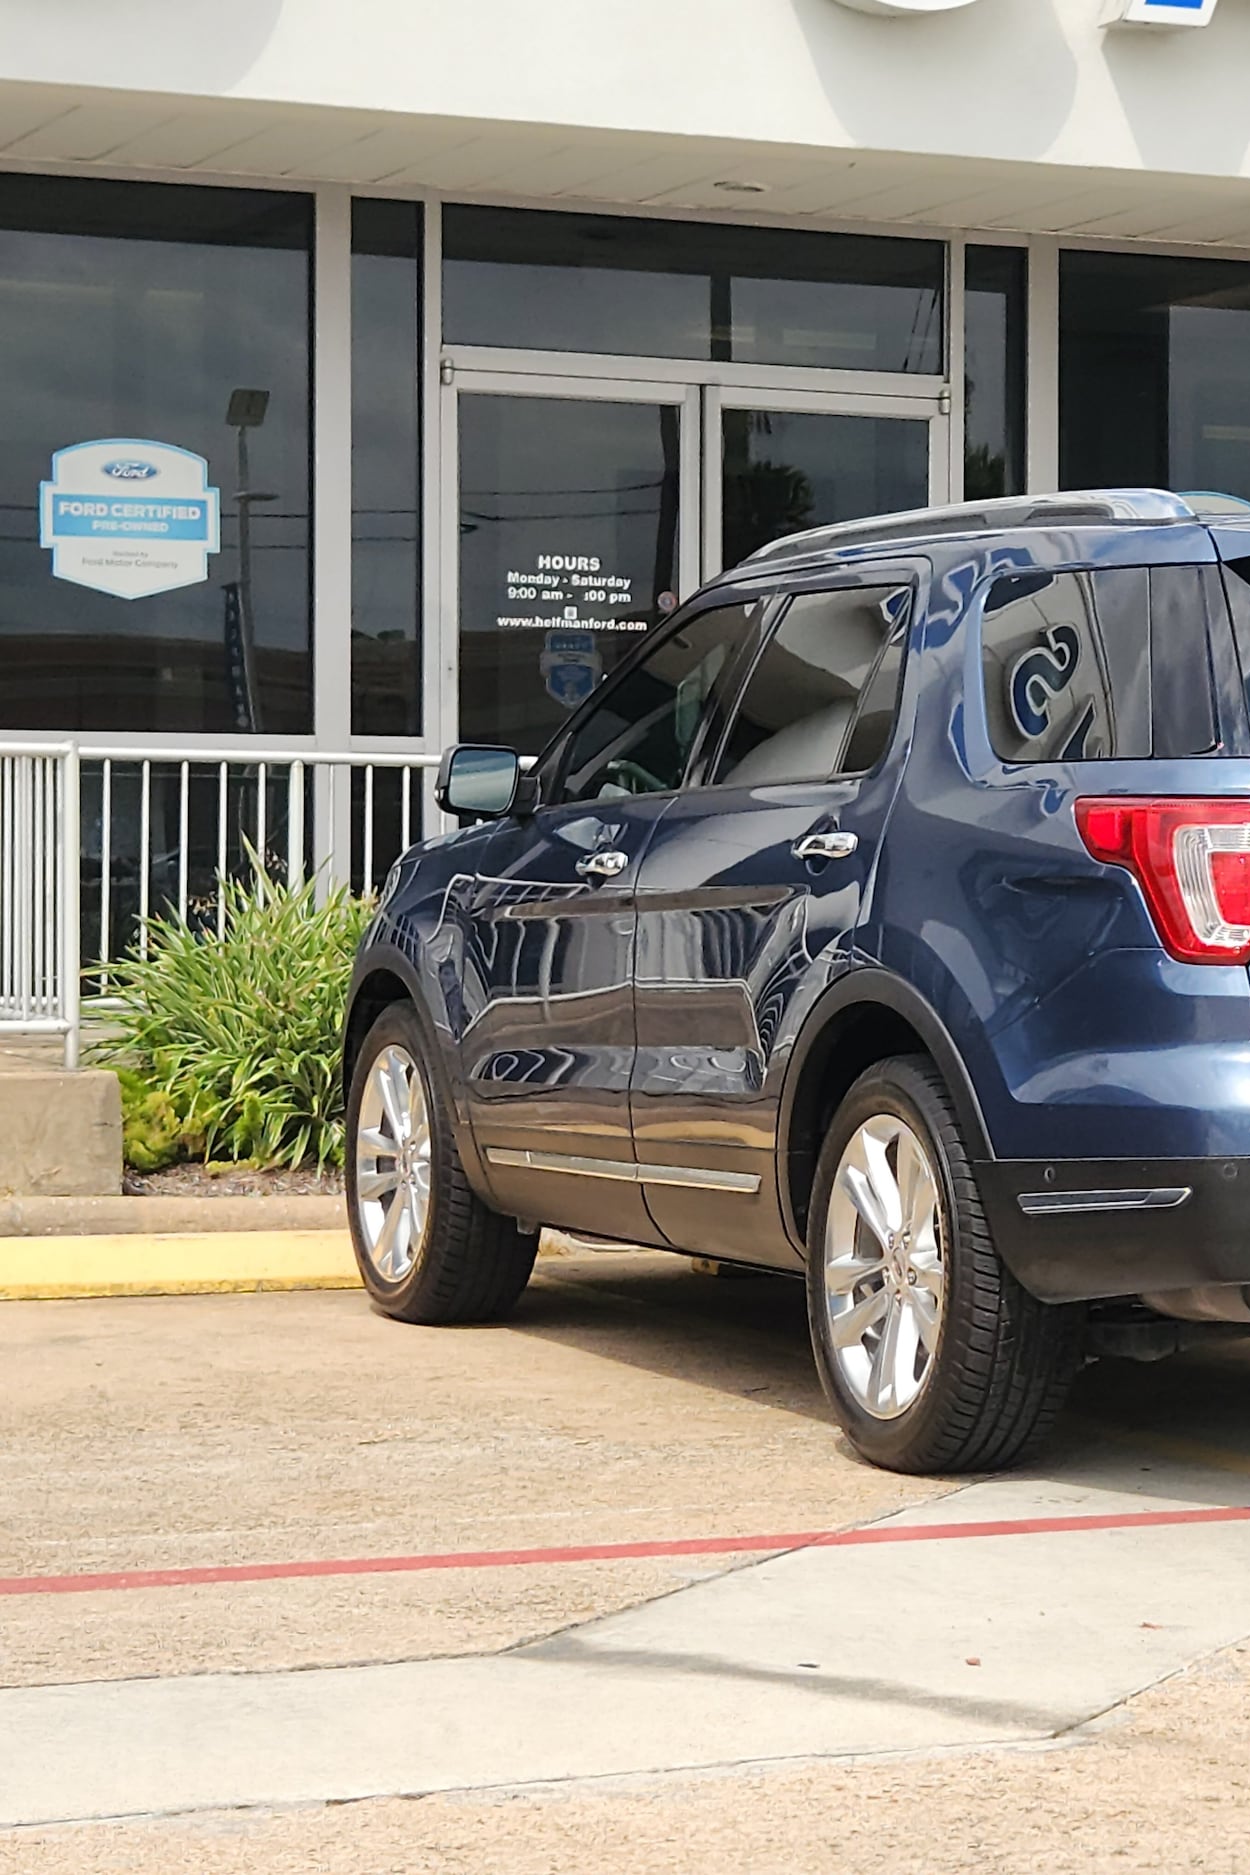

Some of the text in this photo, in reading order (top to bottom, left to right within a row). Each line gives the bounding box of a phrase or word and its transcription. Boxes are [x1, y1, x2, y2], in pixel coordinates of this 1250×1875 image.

[111, 463, 150, 478] Ford
[59, 502, 201, 520] FORD CERTIFIED
[92, 520, 169, 532] PRE-OWNED
[539, 555, 601, 571] HOURS
[507, 571, 560, 587] Monday
[571, 574, 631, 590] Saturday
[507, 587, 537, 599] 9:00
[541, 590, 563, 600] am
[609, 593, 631, 605] pm
[497, 616, 648, 631] www.helfmanford.com
